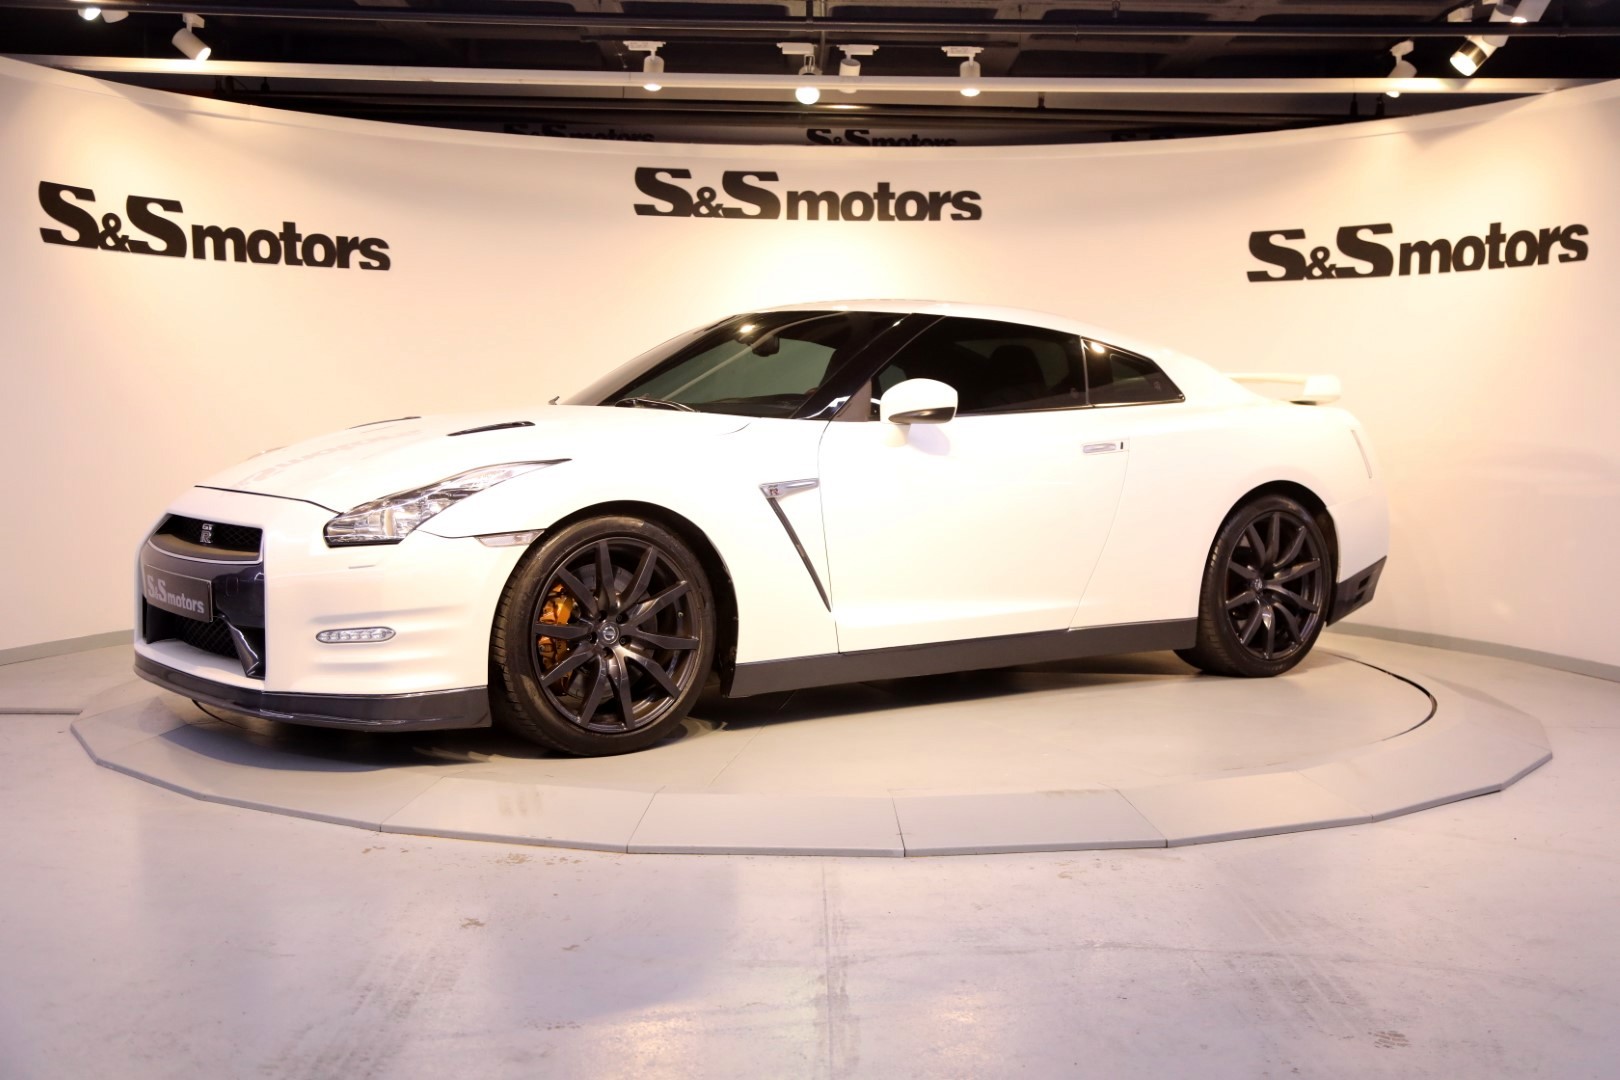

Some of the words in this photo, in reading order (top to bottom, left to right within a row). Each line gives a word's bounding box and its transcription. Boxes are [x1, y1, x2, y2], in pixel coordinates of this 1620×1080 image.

[787, 183, 981, 220] motors
[192, 222, 390, 270] motors
[1399, 223, 1588, 275] motors
